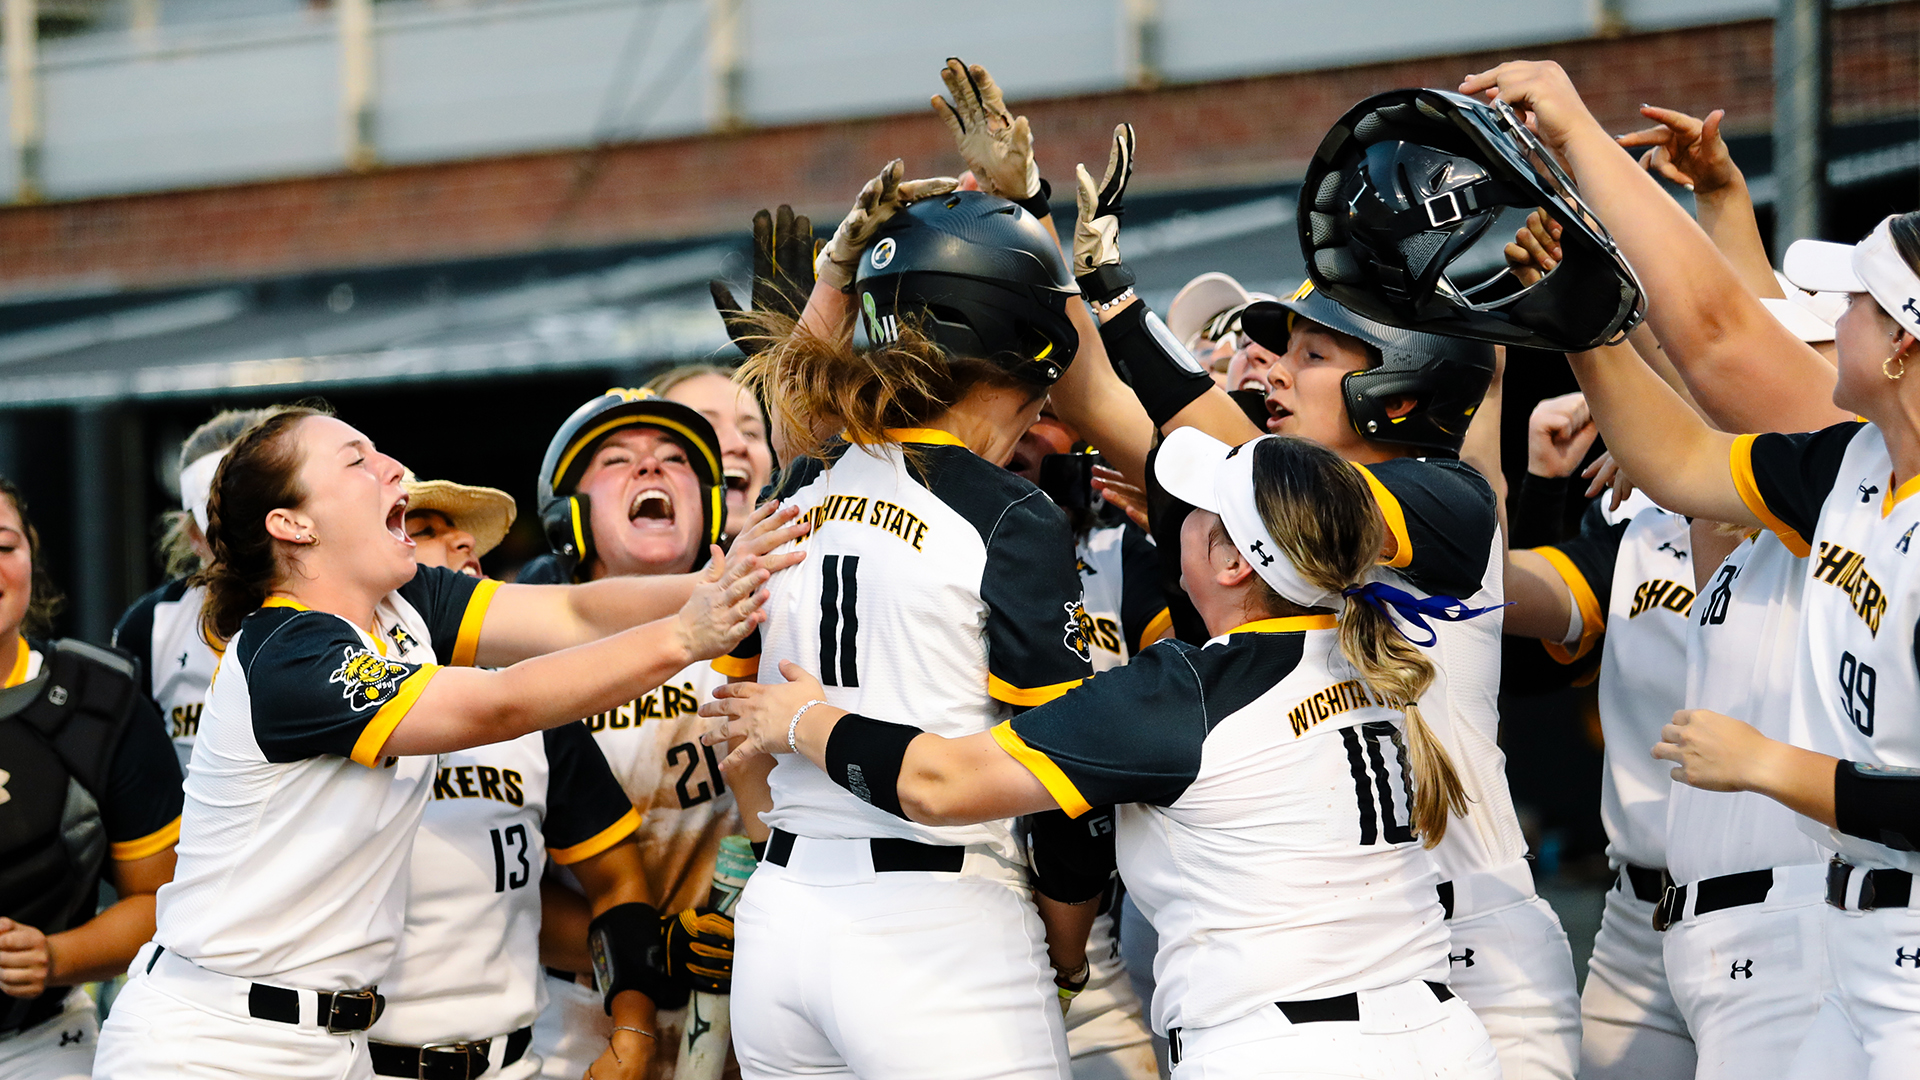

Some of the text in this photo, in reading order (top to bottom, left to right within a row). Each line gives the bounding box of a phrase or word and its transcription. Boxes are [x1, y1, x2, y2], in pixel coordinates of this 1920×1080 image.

[869, 499, 930, 553] STATE
[819, 554, 860, 688] 11
[374, 680, 392, 691] WSU
[1286, 679, 1374, 739] WICHITA
[1838, 650, 1877, 738] 99
[666, 735, 727, 811] 21
[1337, 720, 1419, 846] 10
[489, 823, 530, 894] 13
